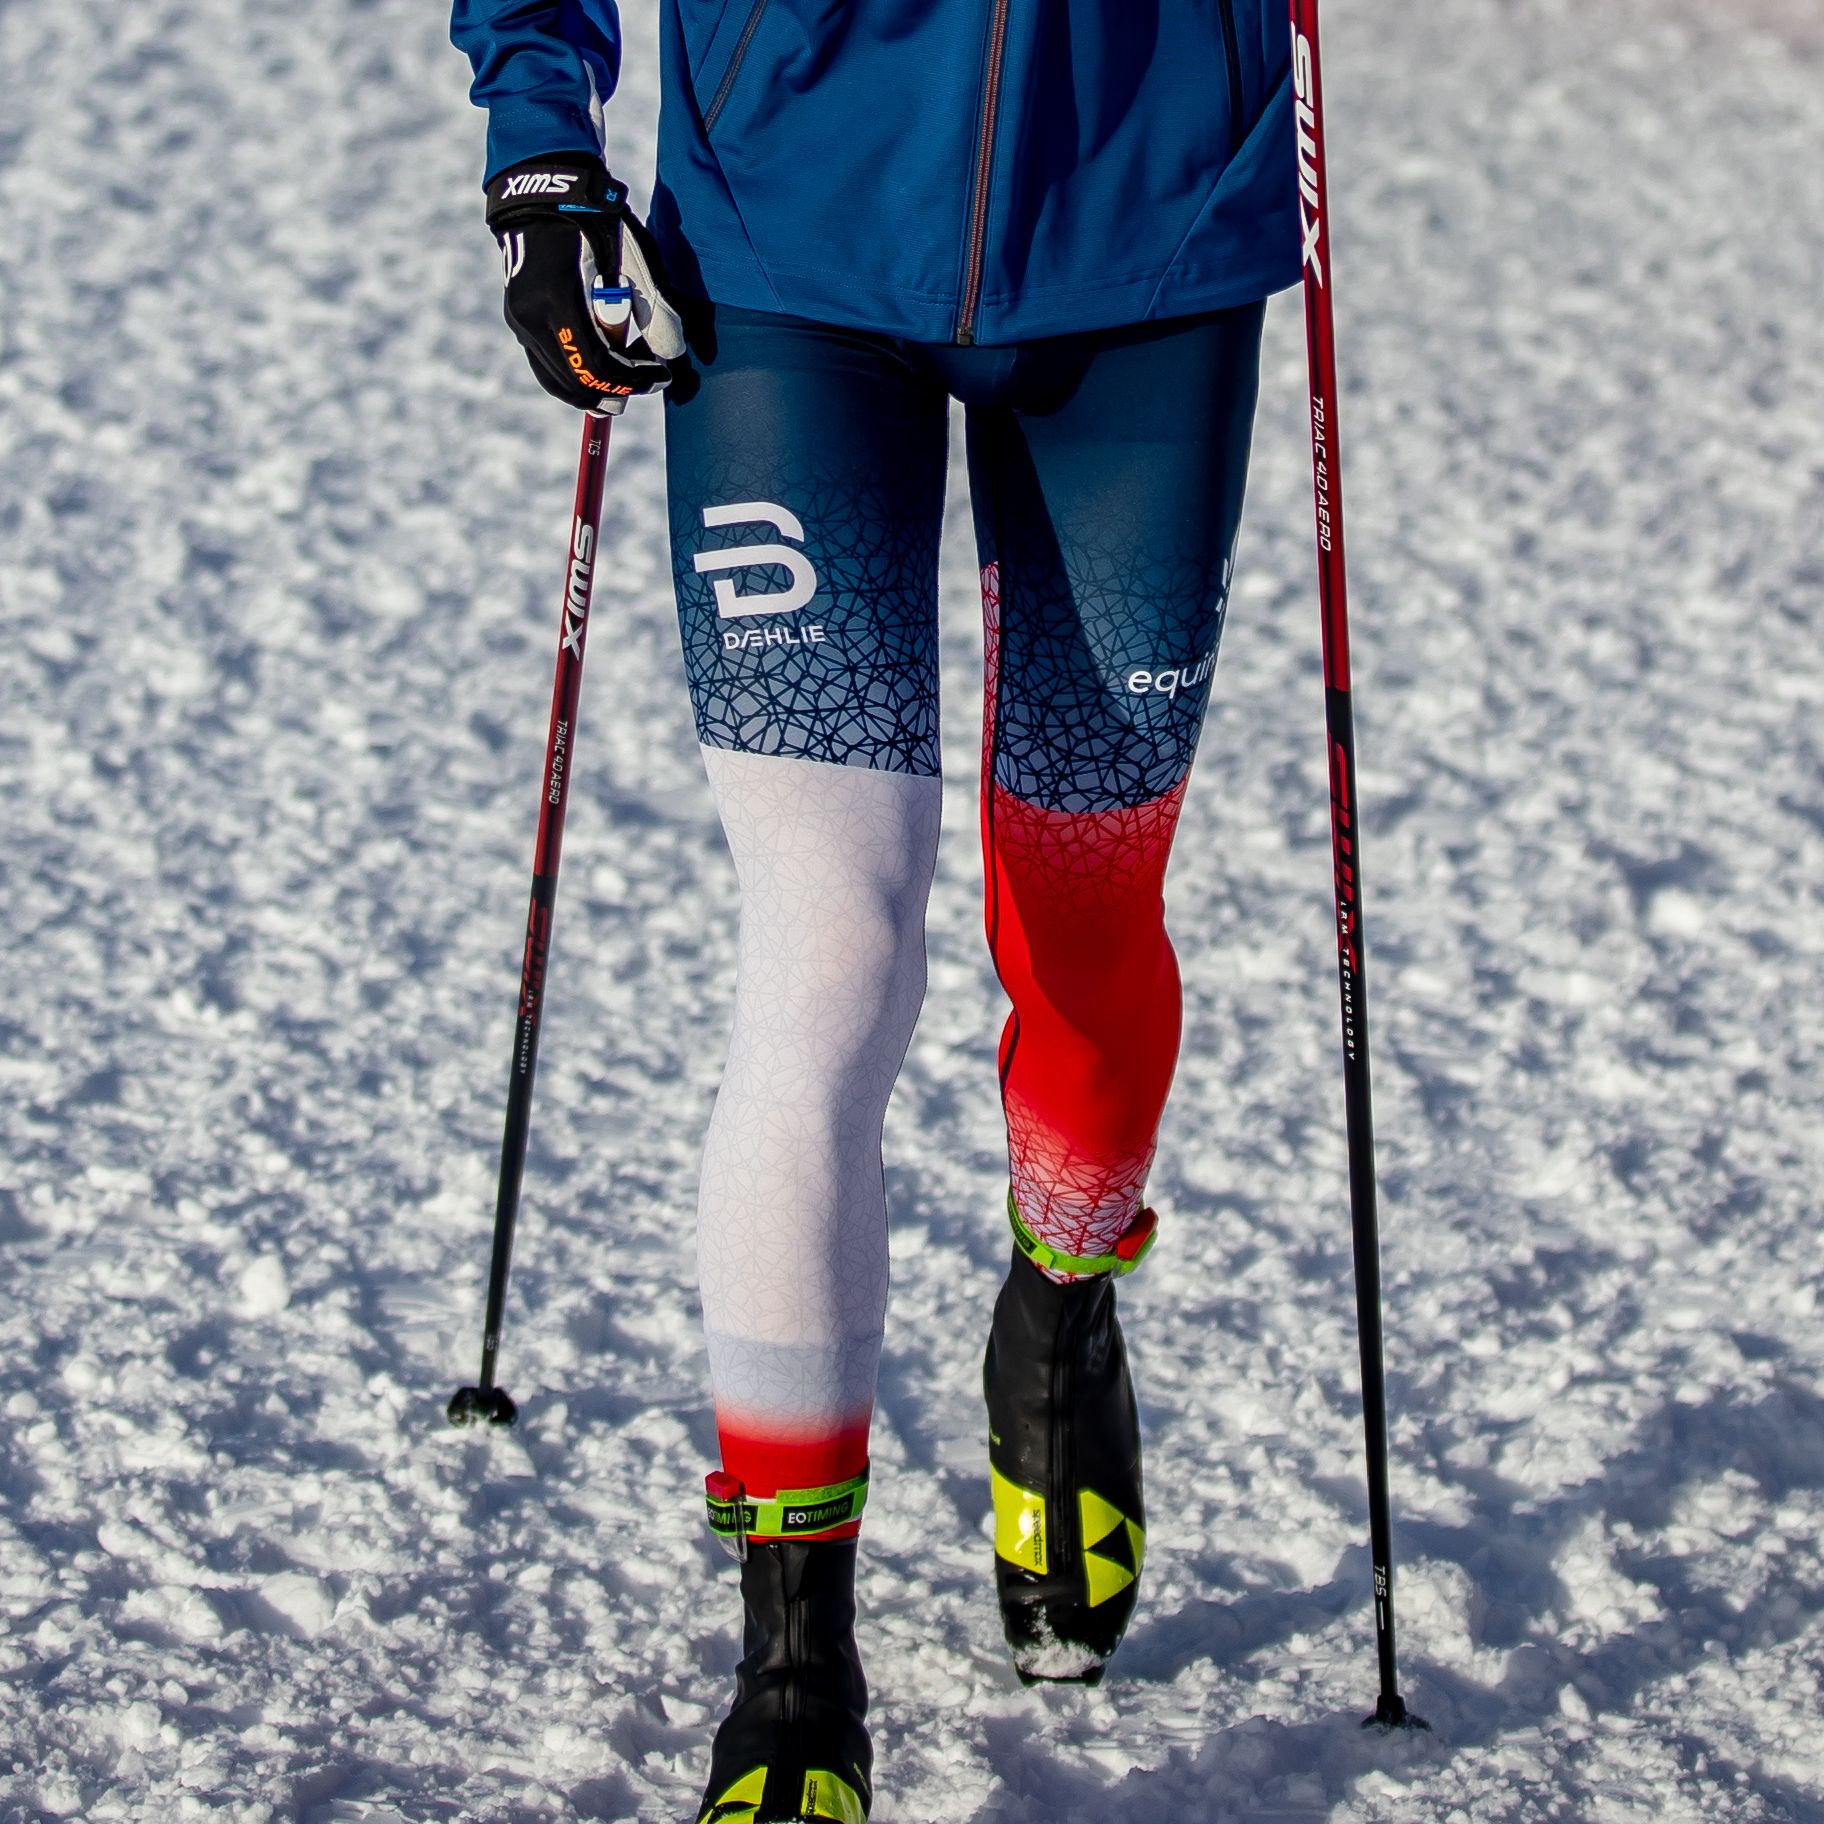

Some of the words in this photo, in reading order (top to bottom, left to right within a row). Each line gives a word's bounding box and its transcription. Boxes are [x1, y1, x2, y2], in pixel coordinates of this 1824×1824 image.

[1290, 20, 1324, 290] SWIX
[501, 173, 579, 200] SWIX
[1313, 396, 1326, 459] TRIAC
[562, 514, 593, 662] SWIX
[723, 624, 826, 651] DÆHLIE
[1127, 650, 1216, 700] equin
[1342, 948, 1357, 1062] TECHNOLOGY
[787, 1501, 850, 1525] EOTIMING
